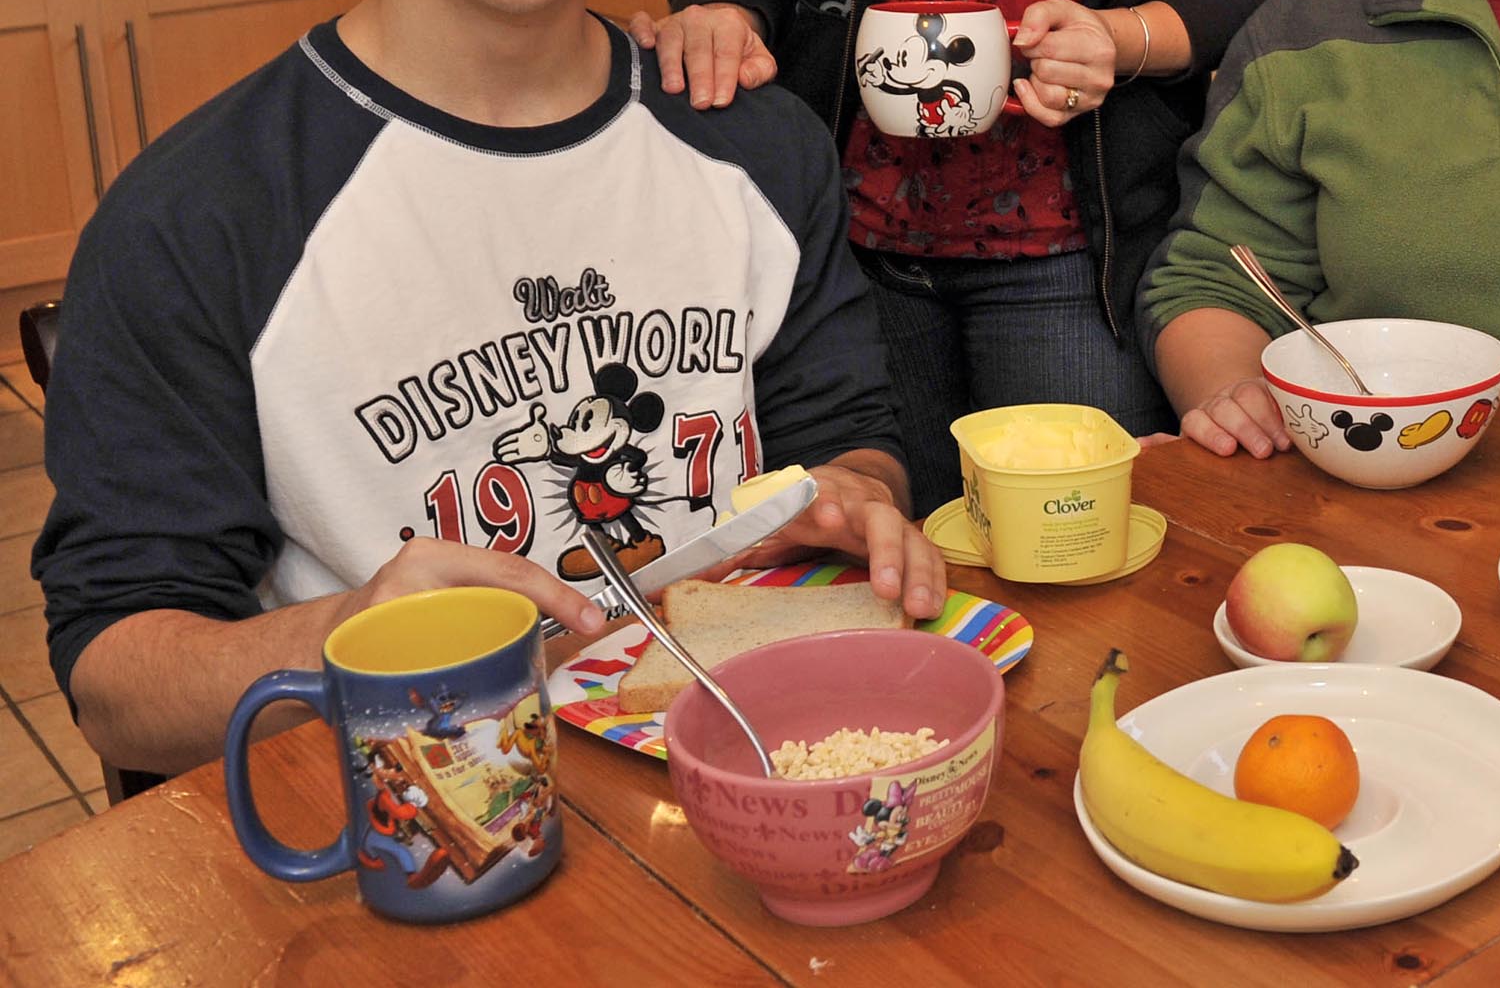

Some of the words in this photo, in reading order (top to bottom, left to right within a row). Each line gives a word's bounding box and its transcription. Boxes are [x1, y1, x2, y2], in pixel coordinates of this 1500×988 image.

[514, 268, 616, 323] Walt
[355, 322, 570, 464] DISNEY
[579, 308, 745, 378] WORL
[1043, 498, 1096, 515] Clover
[914, 771, 946, 786] Disney
[713, 781, 808, 818] News
